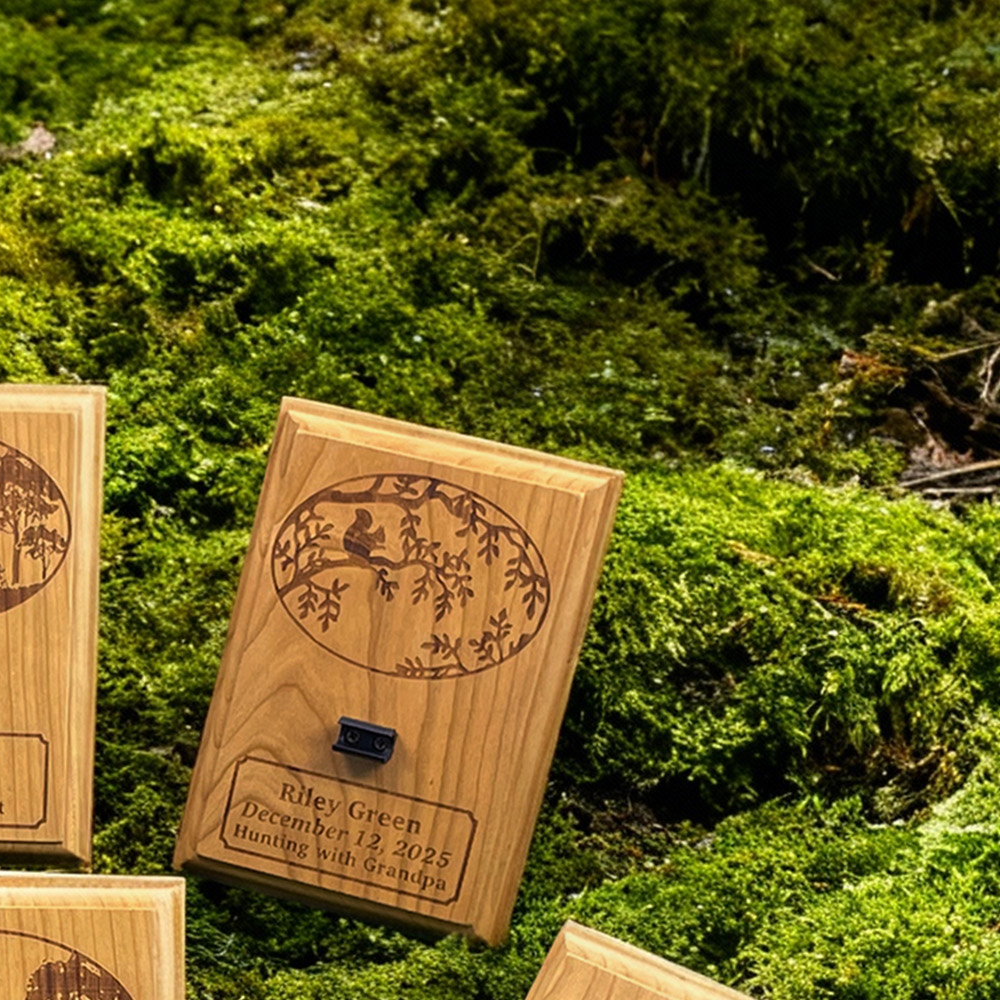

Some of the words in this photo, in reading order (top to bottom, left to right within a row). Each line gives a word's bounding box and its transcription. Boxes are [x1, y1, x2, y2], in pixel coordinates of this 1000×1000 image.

[241, 802, 349, 841] December
[354, 830, 384, 855] 12,
[392, 841, 453, 869] 2025
[279, 783, 341, 817] Riley
[349, 801, 422, 835] Green
[233, 824, 310, 859] Hunting
[317, 848, 356, 868] with
[363, 857, 447, 891] Grandpa
